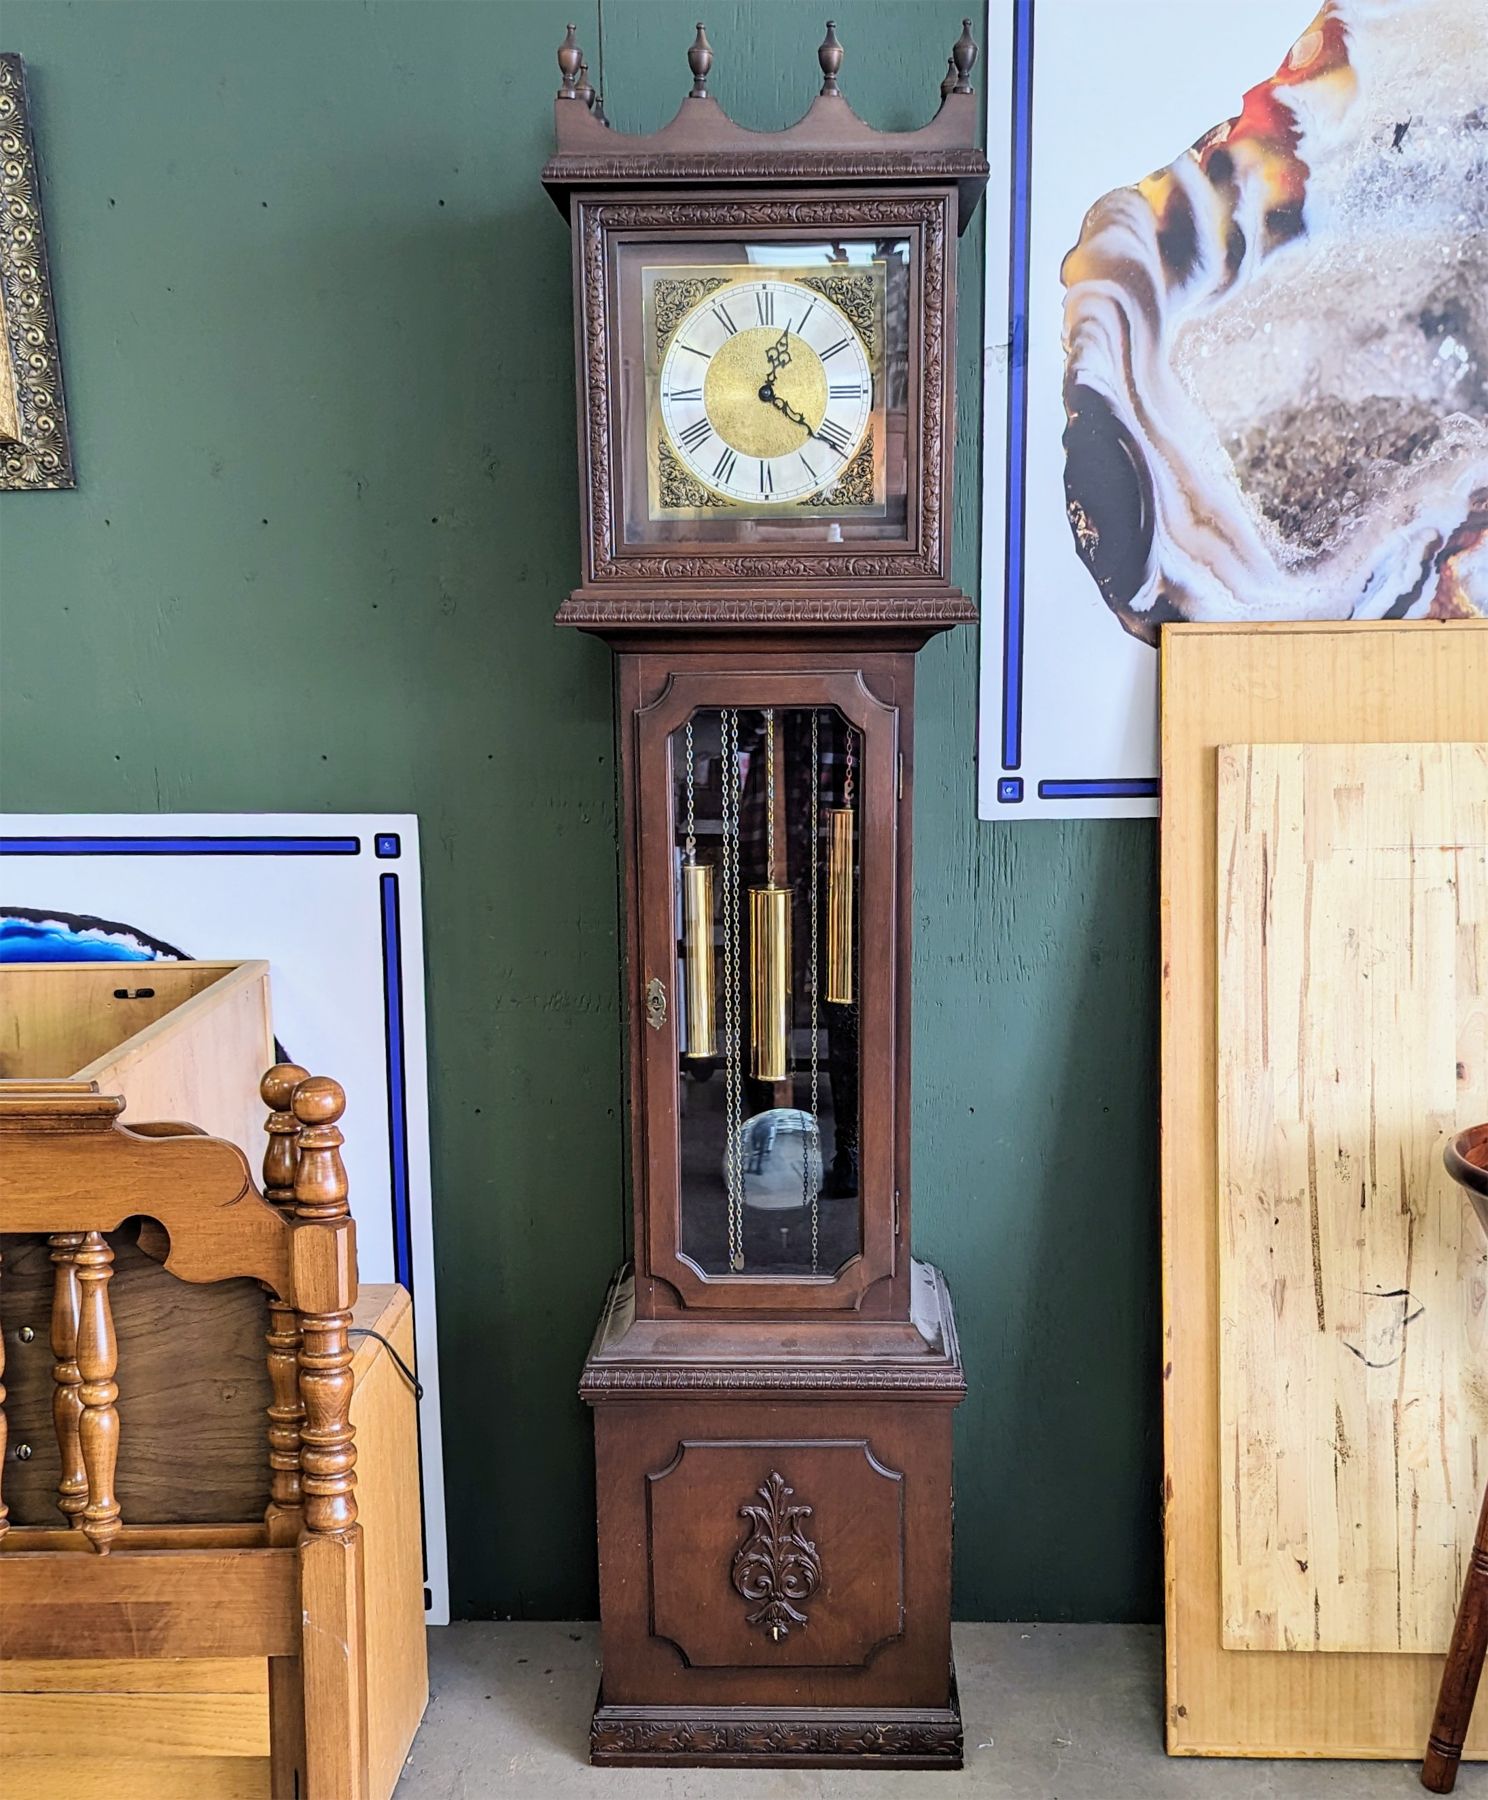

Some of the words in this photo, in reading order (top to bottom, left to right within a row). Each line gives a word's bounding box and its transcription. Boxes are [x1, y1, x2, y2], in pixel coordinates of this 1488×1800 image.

[711, 303, 738, 339] XI
[755, 291, 774, 327] XII
[796, 304, 814, 334] I
[681, 339, 712, 365] X
[819, 337, 850, 362] II
[670, 386, 702, 401] IX
[829, 385, 861, 399] III
[679, 417, 714, 454] VIII
[712, 447, 738, 484] VII
[760, 460, 773, 493] VI
[798, 451, 817, 481] V
